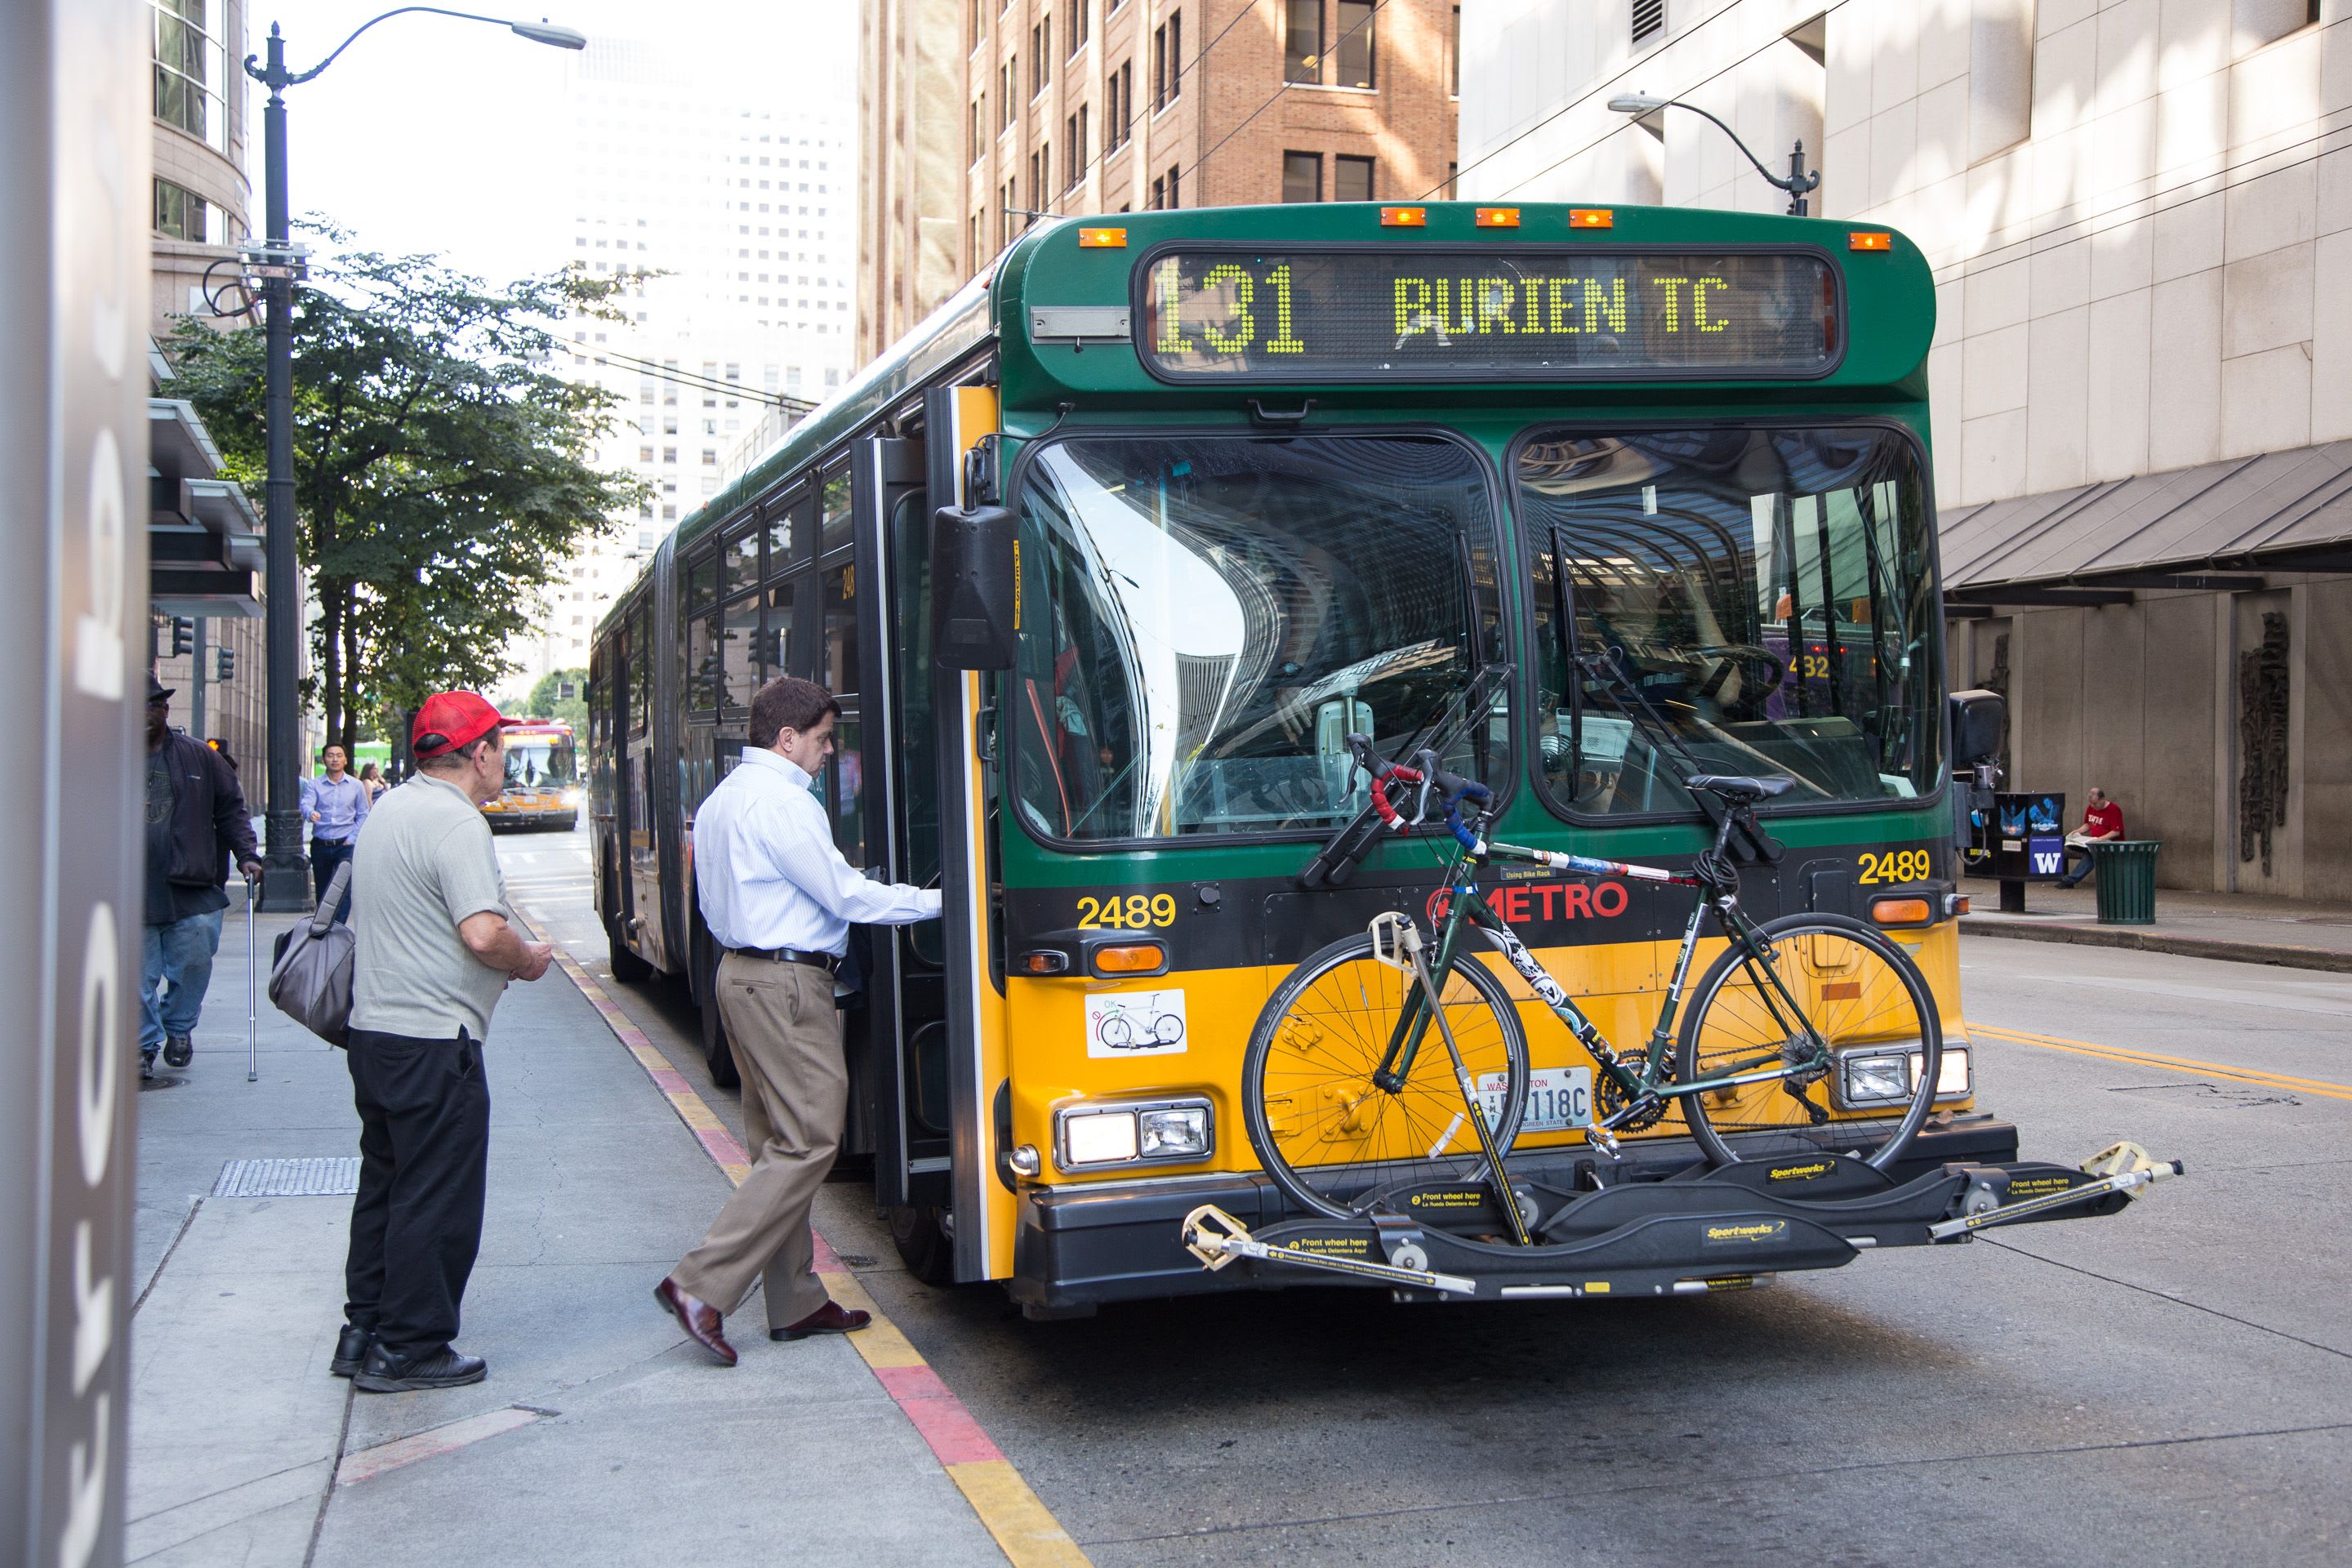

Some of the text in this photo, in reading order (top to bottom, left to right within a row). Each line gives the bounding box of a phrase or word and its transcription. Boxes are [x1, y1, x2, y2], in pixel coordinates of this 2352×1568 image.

[1154, 263, 1729, 353] 131 BURIEN TC
[1858, 849, 1930, 884] 2489
[2034, 853, 2060, 874] W
[1076, 893, 1176, 930] 2489
[1104, 1000, 1117, 1009] OK
[1486, 1079, 1548, 1092] WASTON
[1500, 1086, 1587, 1121] 118C
[1770, 1164, 1825, 1179] Sportworks
[2011, 1178, 2030, 1188] Front
[2031, 1178, 2052, 1187] wheel
[1422, 1192, 1441, 1200] Front
[1707, 1224, 1773, 1239] Sportworks
[1301, 1238, 1321, 1247] Front
[1325, 1238, 1348, 1246] wheel
